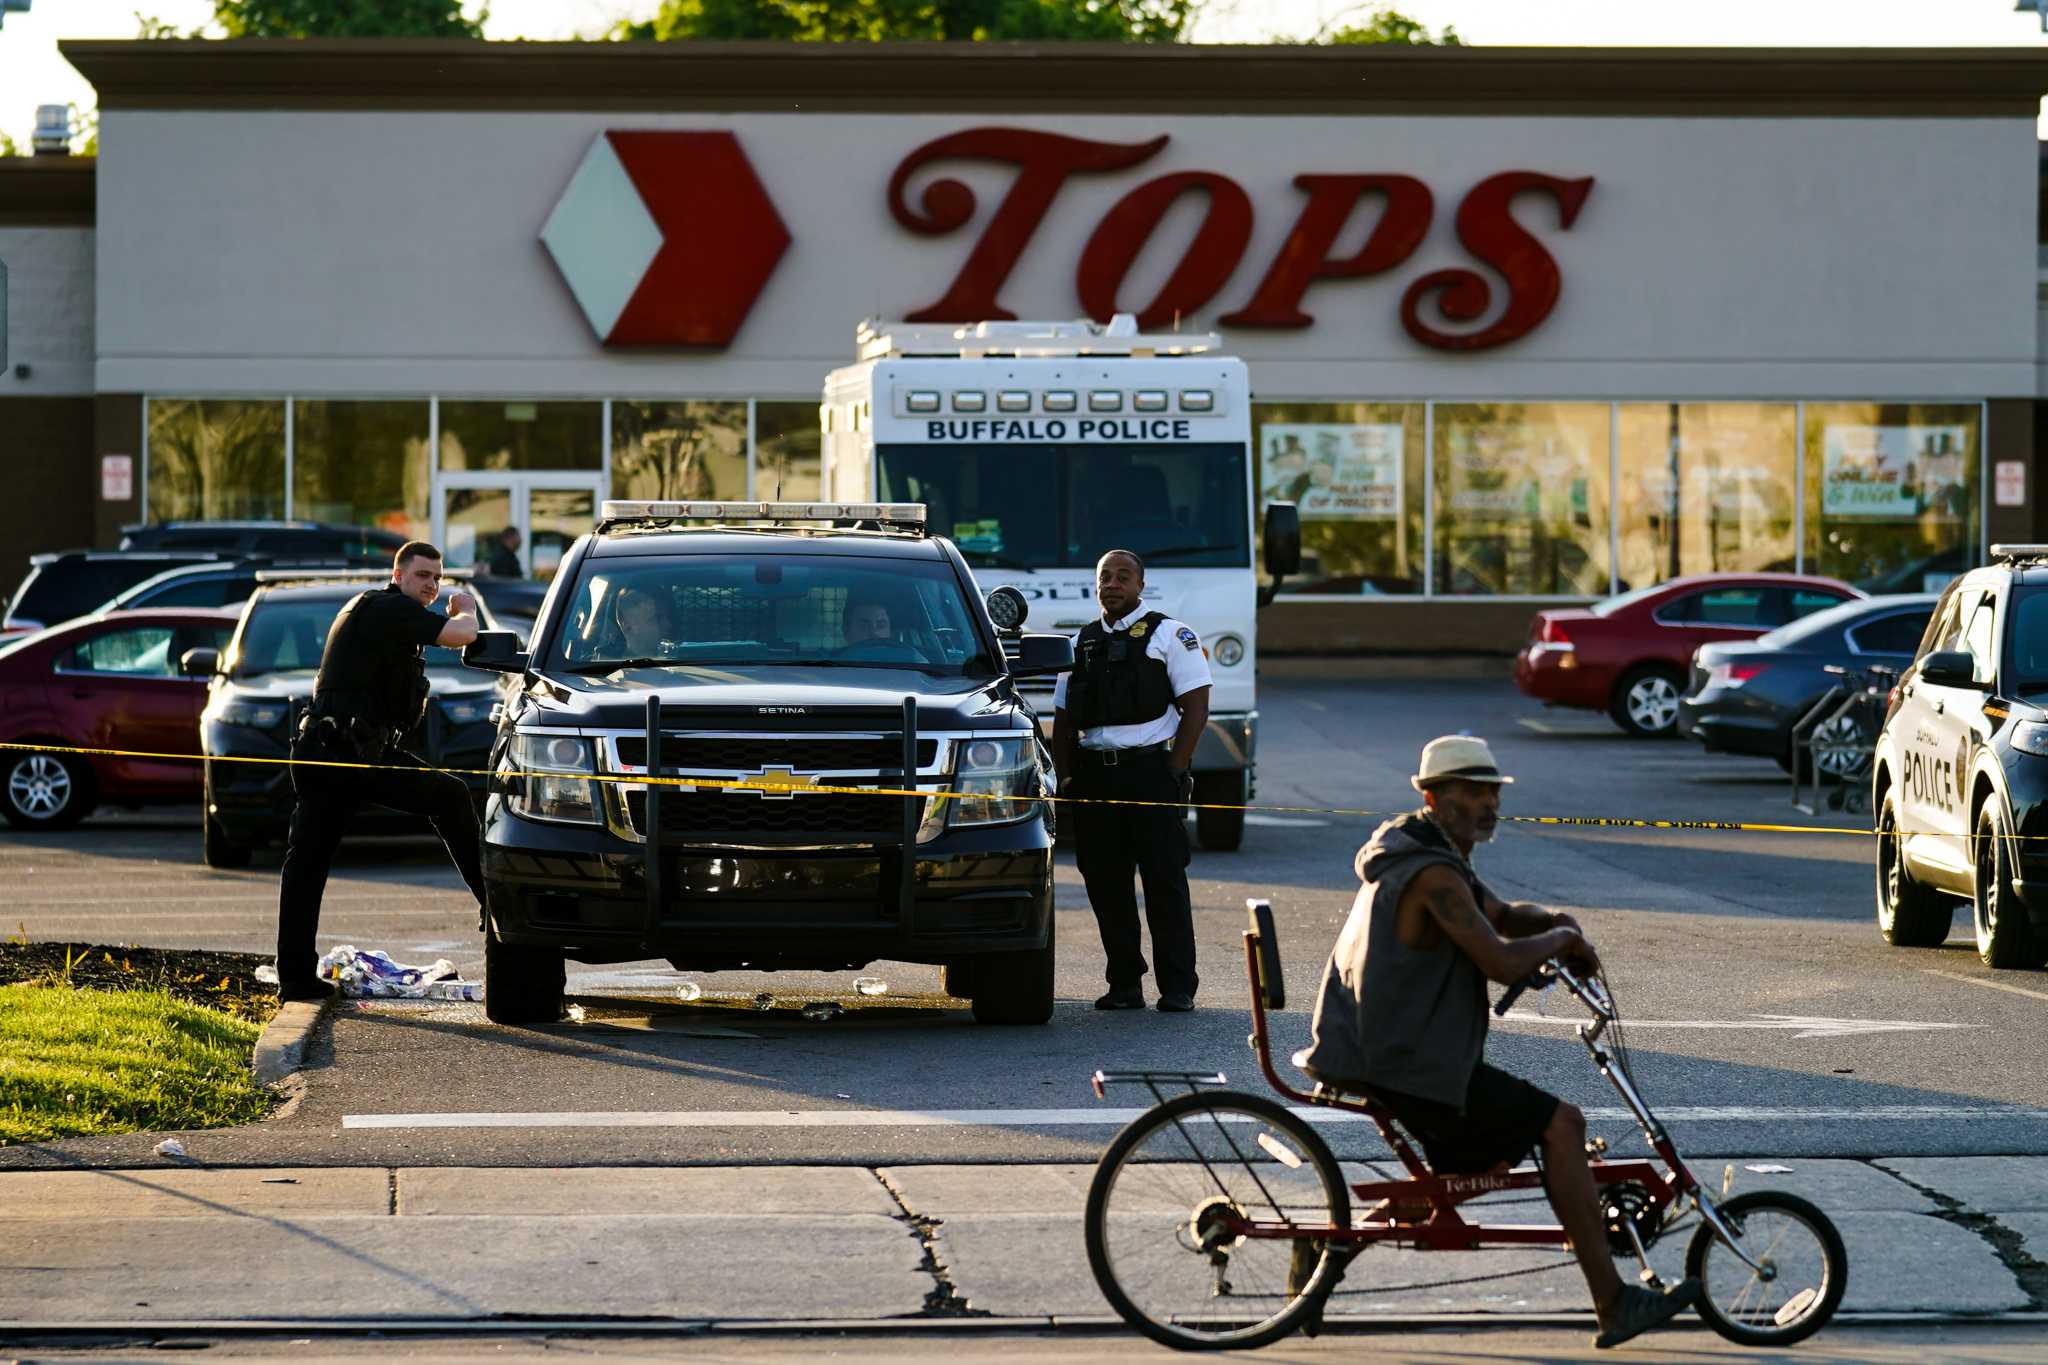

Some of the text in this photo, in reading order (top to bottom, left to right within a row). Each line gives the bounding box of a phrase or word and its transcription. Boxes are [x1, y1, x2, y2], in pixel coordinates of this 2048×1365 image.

[888, 126, 1595, 352] TOPS
[927, 420, 1190, 440] BUFFALO POLICE
[1902, 750, 1953, 814] POLICE
